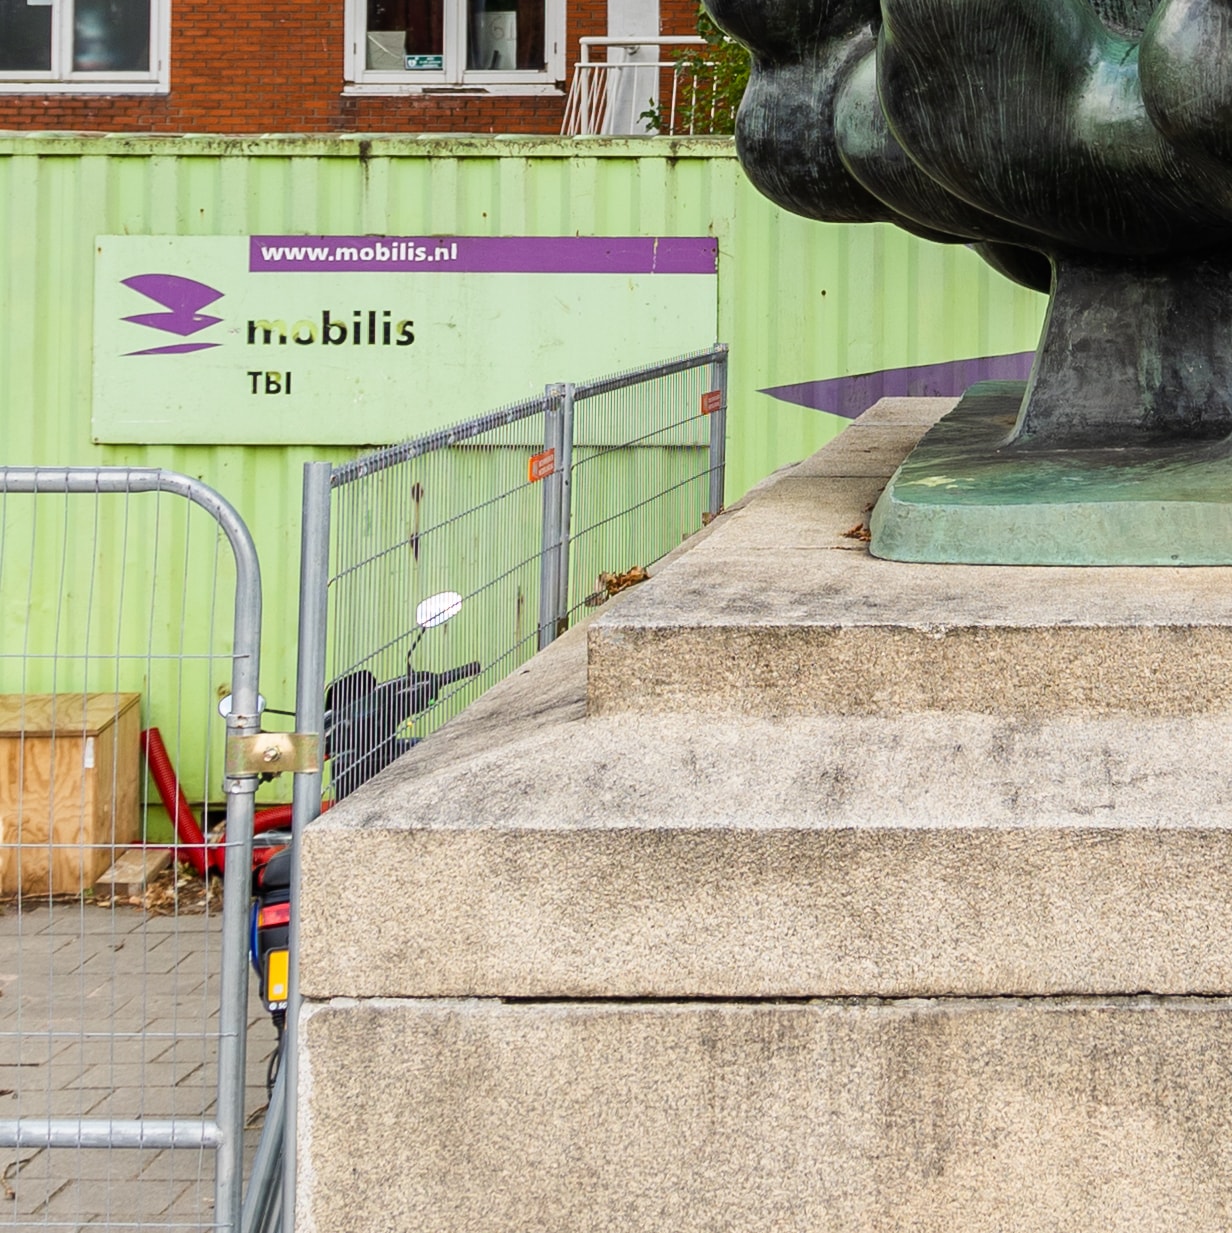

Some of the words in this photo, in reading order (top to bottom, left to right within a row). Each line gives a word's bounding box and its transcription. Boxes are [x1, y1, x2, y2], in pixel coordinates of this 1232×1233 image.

[261, 242, 457, 261] www.mobilis.nl
[247, 310, 415, 346] mobilis
[247, 371, 292, 395] TBI
